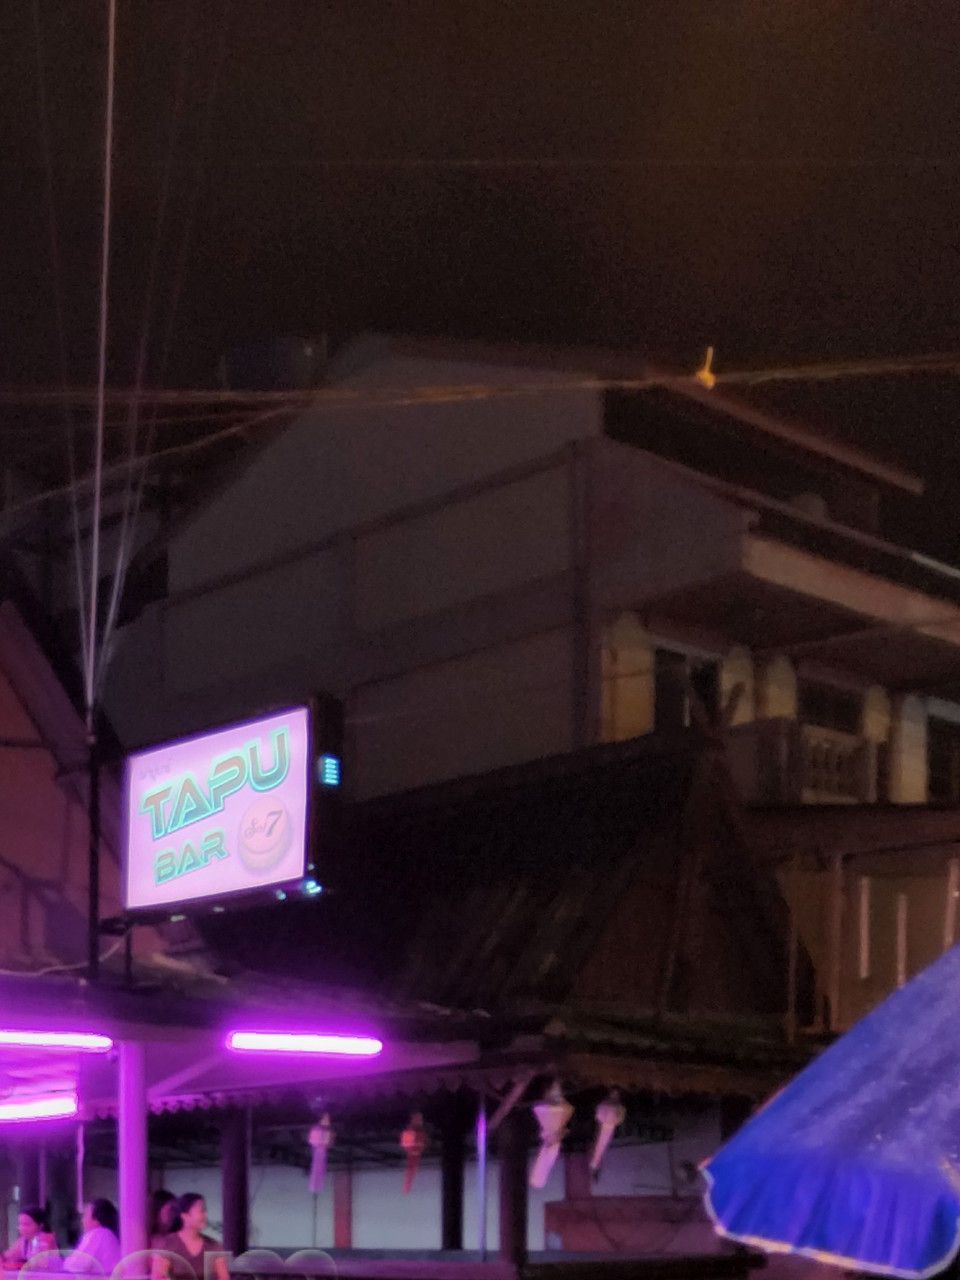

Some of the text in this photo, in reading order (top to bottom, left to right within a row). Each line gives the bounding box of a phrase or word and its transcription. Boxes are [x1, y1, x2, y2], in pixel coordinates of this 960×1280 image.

[140, 727, 288, 840] TAPU
[265, 809, 283, 837] 7
[154, 830, 229, 885] BAR
